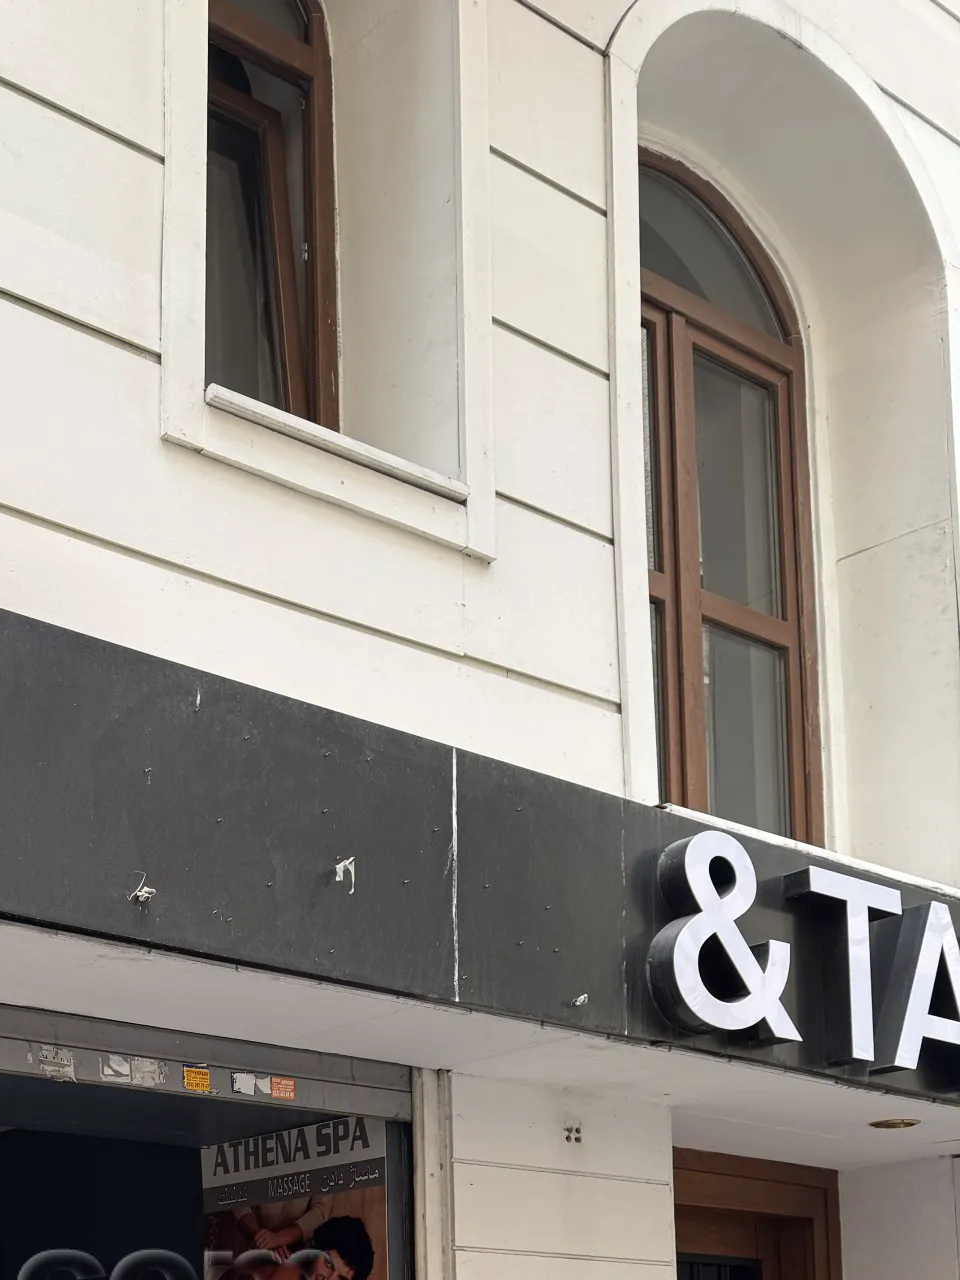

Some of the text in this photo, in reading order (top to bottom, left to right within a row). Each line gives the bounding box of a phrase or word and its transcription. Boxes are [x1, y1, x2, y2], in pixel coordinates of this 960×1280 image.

[212, 1117, 371, 1177] ATHENA SPA
[268, 1173, 311, 1198] MASSAGE
